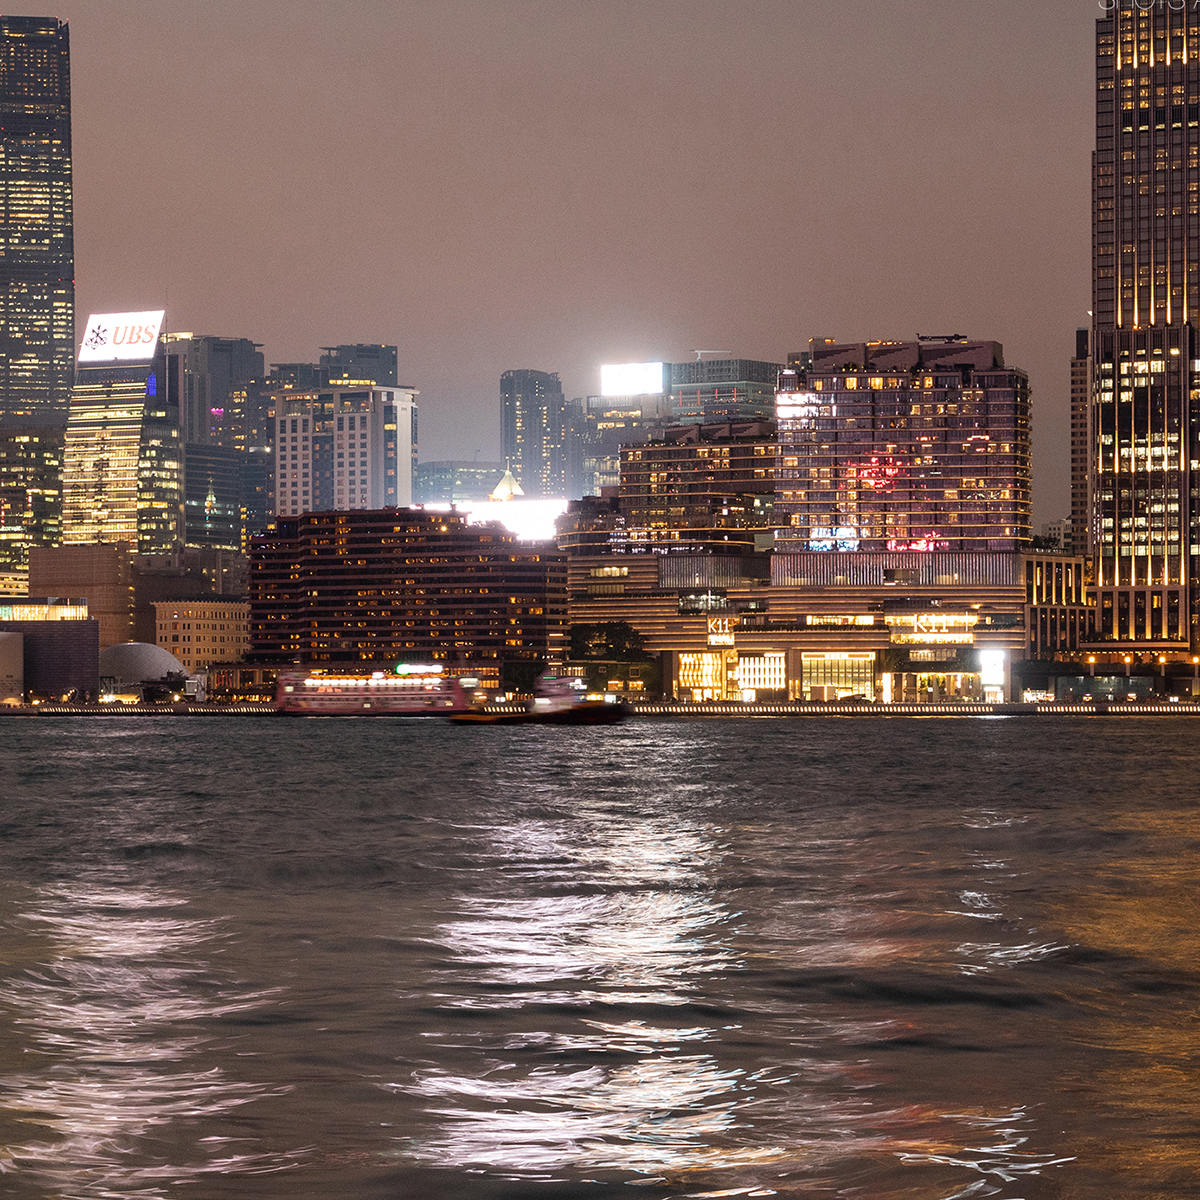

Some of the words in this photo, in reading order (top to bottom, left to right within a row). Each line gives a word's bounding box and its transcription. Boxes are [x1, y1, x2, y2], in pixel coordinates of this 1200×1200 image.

[112, 324, 156, 345] UBS
[708, 617, 730, 633] K11
[914, 613, 949, 632] K11
